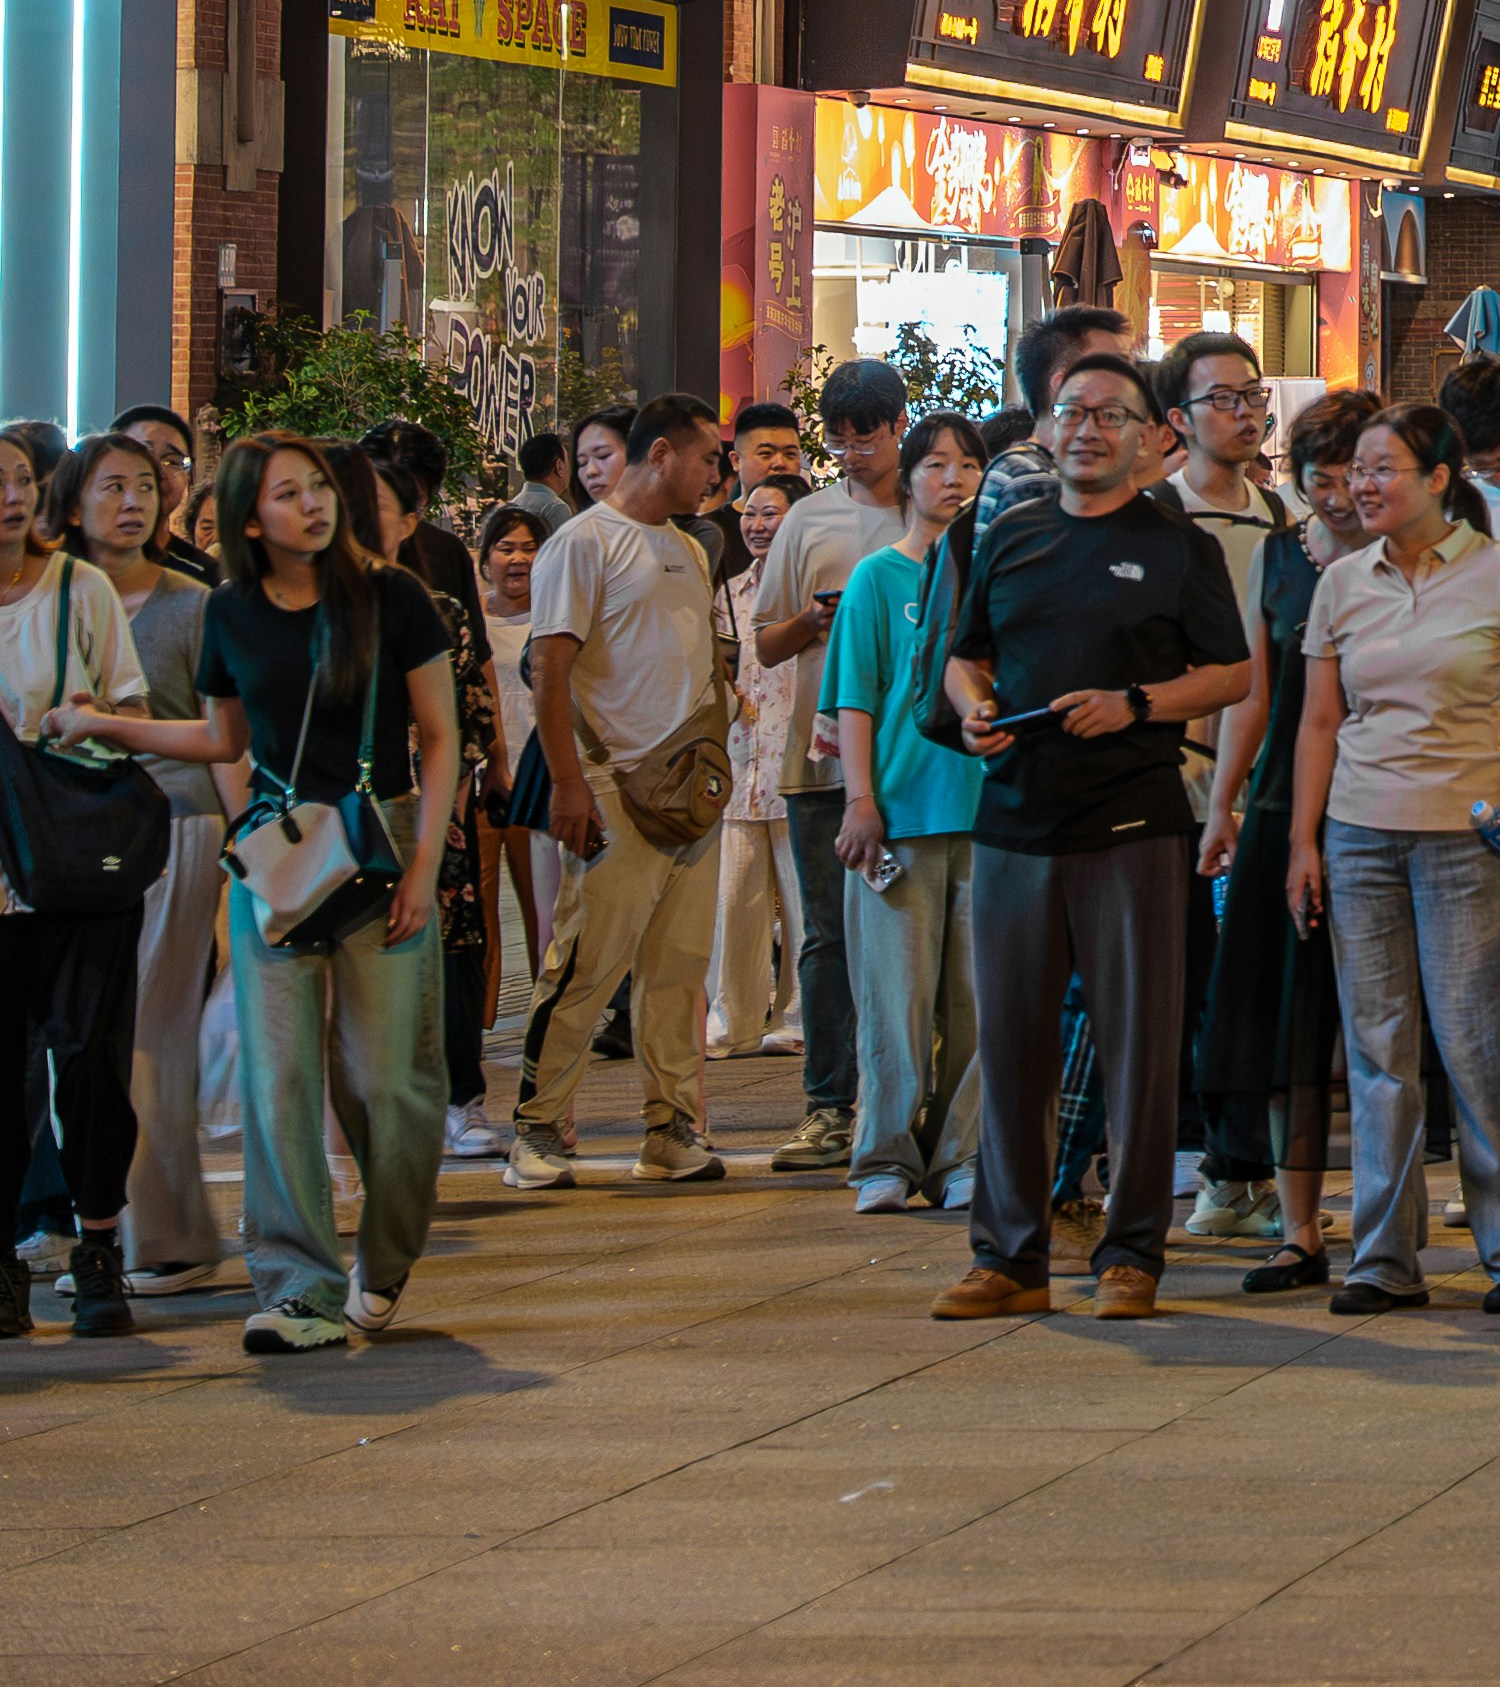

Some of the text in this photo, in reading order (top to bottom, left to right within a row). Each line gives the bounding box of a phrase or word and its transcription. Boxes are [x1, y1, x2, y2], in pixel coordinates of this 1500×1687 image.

[446, 161, 514, 302] KNOW
[505, 266, 545, 348] YOUR
[446, 312, 537, 470] POWER
